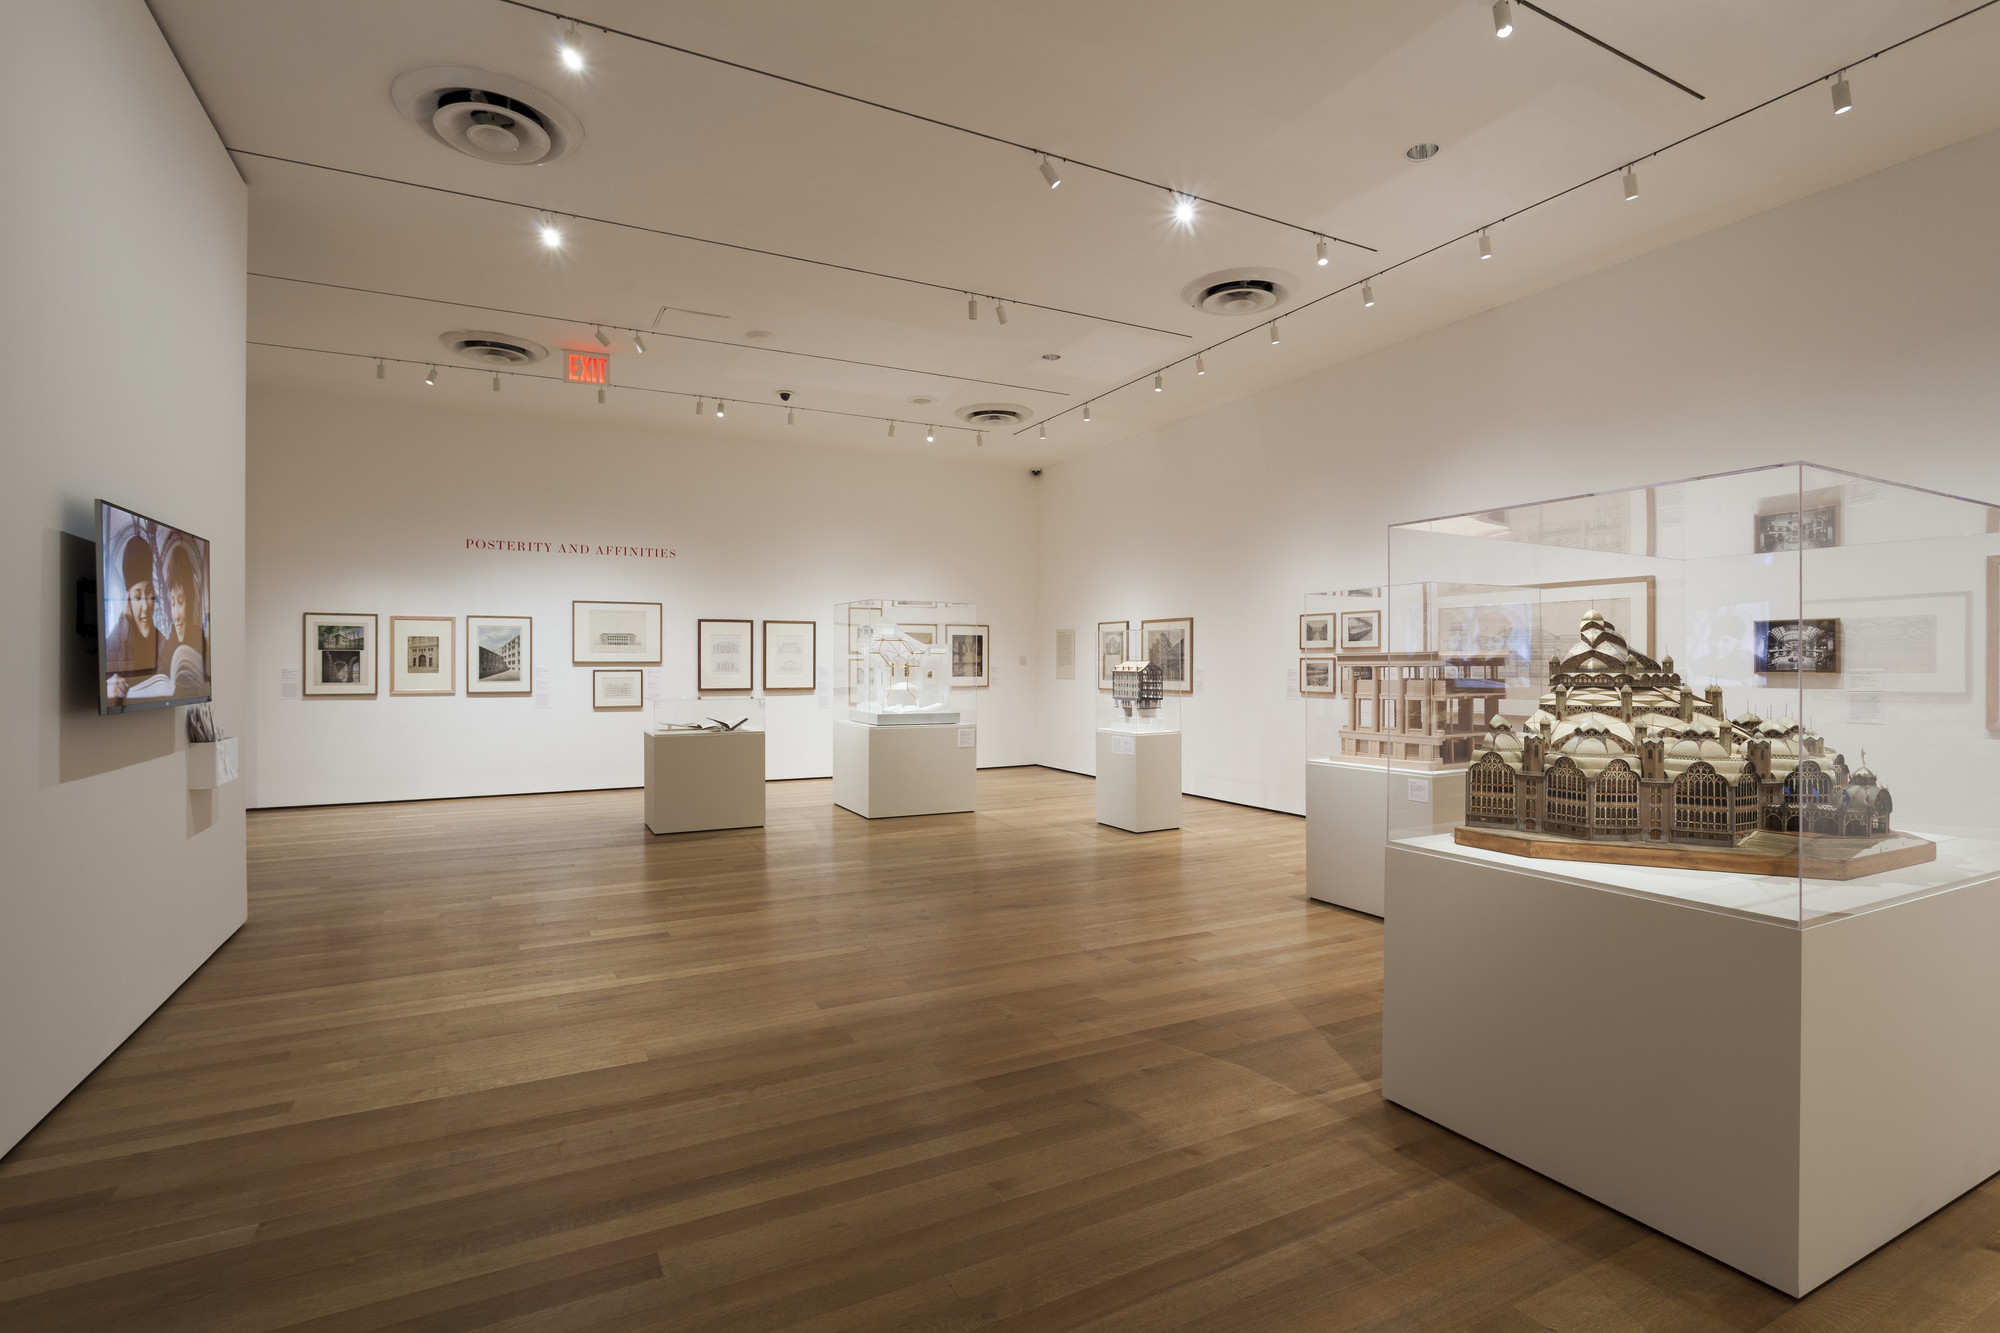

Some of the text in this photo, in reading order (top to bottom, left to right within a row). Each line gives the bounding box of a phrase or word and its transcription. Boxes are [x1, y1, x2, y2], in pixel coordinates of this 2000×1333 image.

[569, 355, 607, 384] EXIT
[466, 538, 676, 558] POSTERITY AND AFFINITIES
